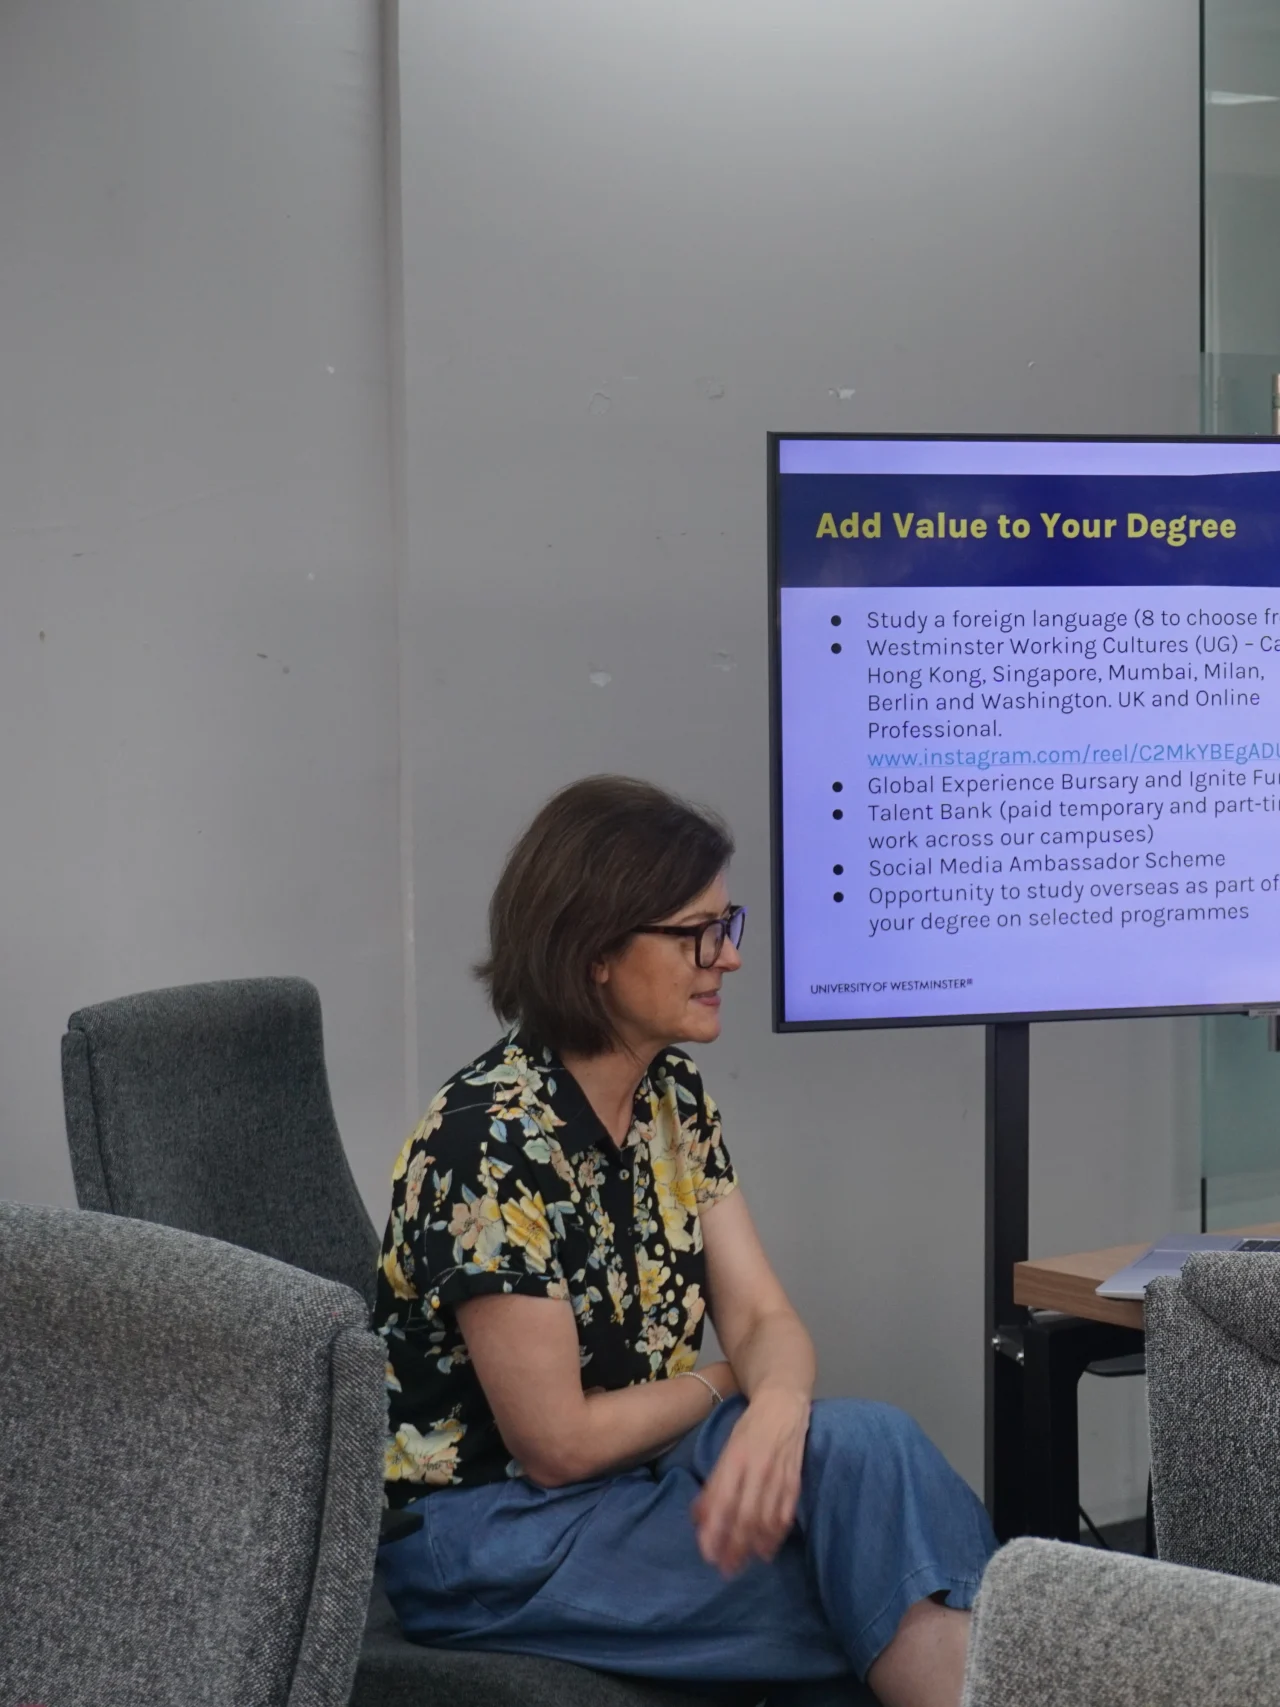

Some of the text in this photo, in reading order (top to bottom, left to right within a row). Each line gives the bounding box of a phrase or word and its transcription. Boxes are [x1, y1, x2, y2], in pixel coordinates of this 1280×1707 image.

[815, 511, 1237, 547] Add Value to Your Degree
[867, 610, 928, 634] Study
[934, 614, 945, 628] a
[952, 609, 1025, 634] foreign
[1033, 609, 1128, 633] language
[1134, 608, 1155, 629] (8
[1160, 610, 1181, 627] to
[1186, 608, 1258, 626] choose
[866, 637, 1005, 656] Westminster
[1009, 636, 1097, 660] Working
[1102, 635, 1189, 654] Cultures
[1195, 634, 1238, 655] (UG)
[868, 661, 1265, 690] Hong Kong, Singapore, Mumbai, Milan,
[868, 688, 1260, 715] Berlin and Washington. UK and Online
[868, 719, 1002, 739] Professional.
[868, 775, 934, 795] Global
[942, 773, 1055, 798] Experience
[1061, 773, 1139, 795] Bursary
[1145, 770, 1182, 788] and
[1190, 770, 1247, 792] Ignite
[867, 803, 934, 822] Talent
[940, 801, 992, 820] Bank
[999, 799, 1052, 824] (paid
[1058, 801, 1164, 822] temporary
[1169, 796, 1207, 815] and
[868, 825, 1154, 849] work across our campuses)
[869, 850, 1226, 877] Social Media Ambassador Scheme
[868, 873, 1280, 910] Opportunity to study overseas as part of
[868, 906, 1249, 938] your degree on selected programmes
[810, 978, 966, 995] UNIVERSITY OF WESTMINSTER
